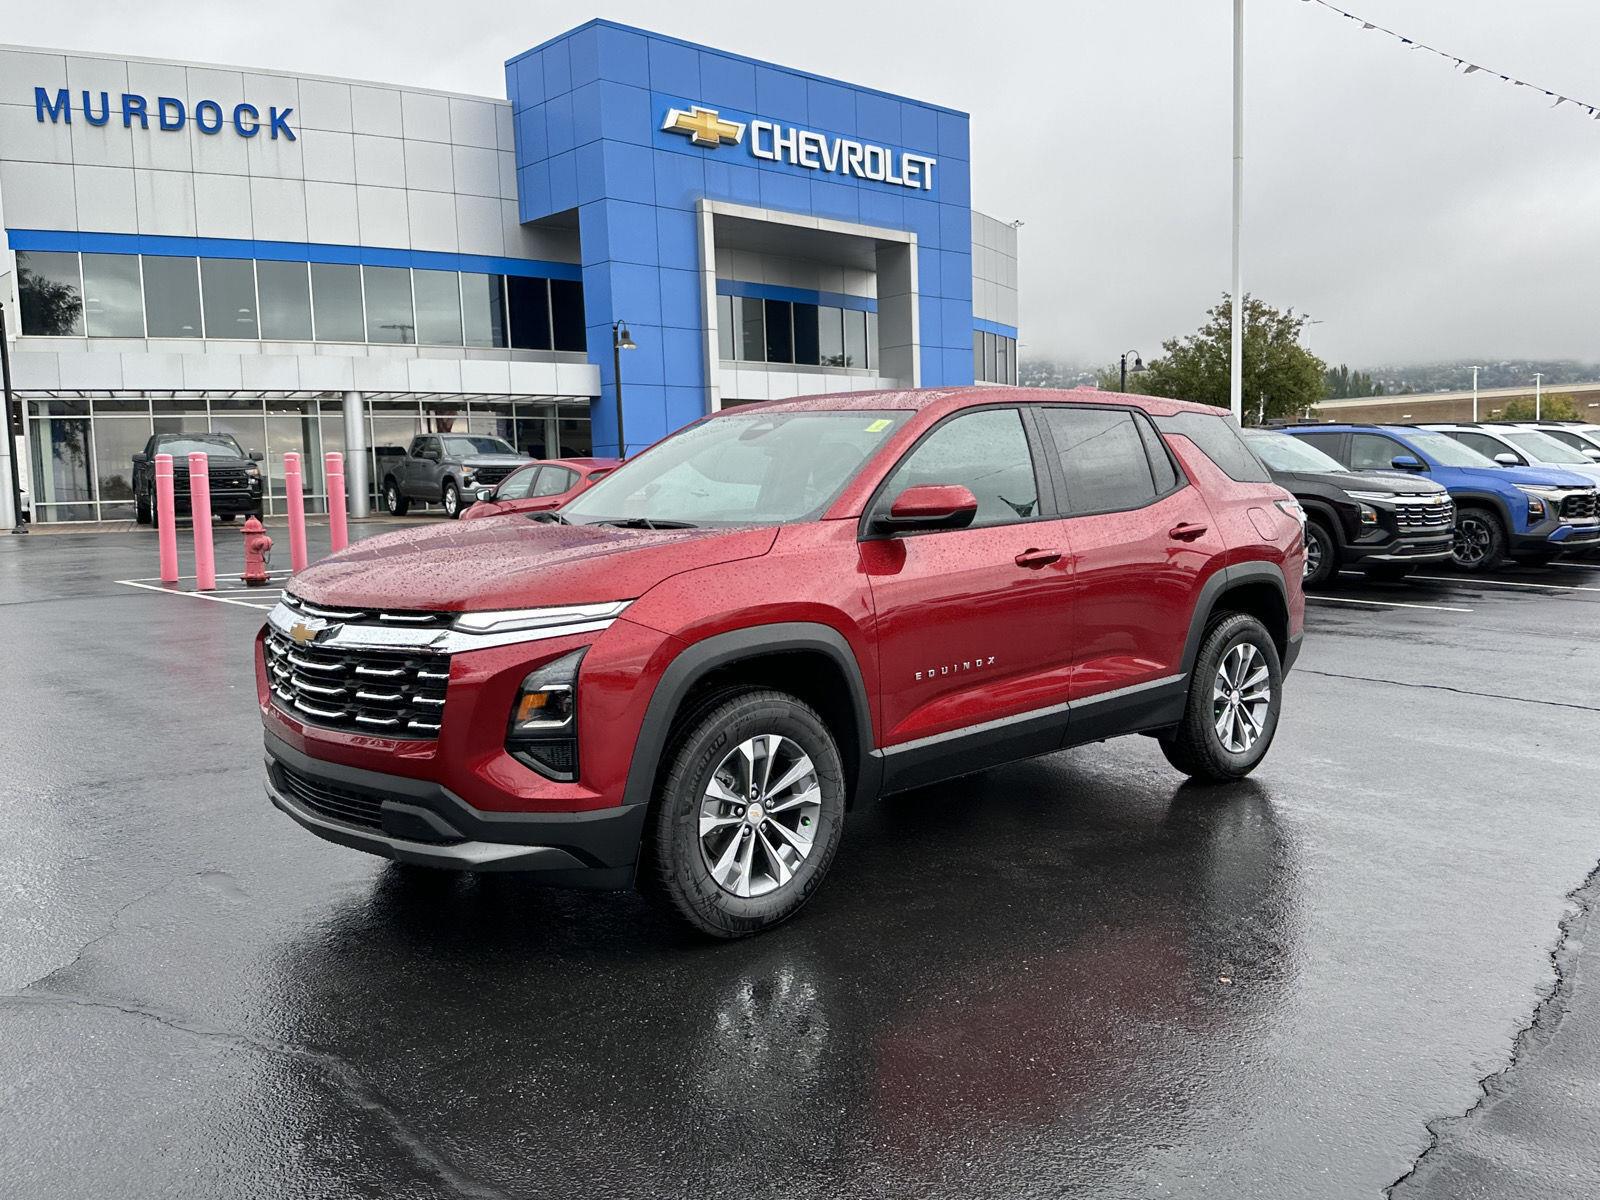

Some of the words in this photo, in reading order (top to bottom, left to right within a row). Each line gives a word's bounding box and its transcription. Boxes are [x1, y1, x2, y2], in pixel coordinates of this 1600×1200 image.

[34, 86, 297, 141] MURDOCK
[751, 119, 937, 190] CHEVROLET
[915, 656, 995, 681] EQUINOX
